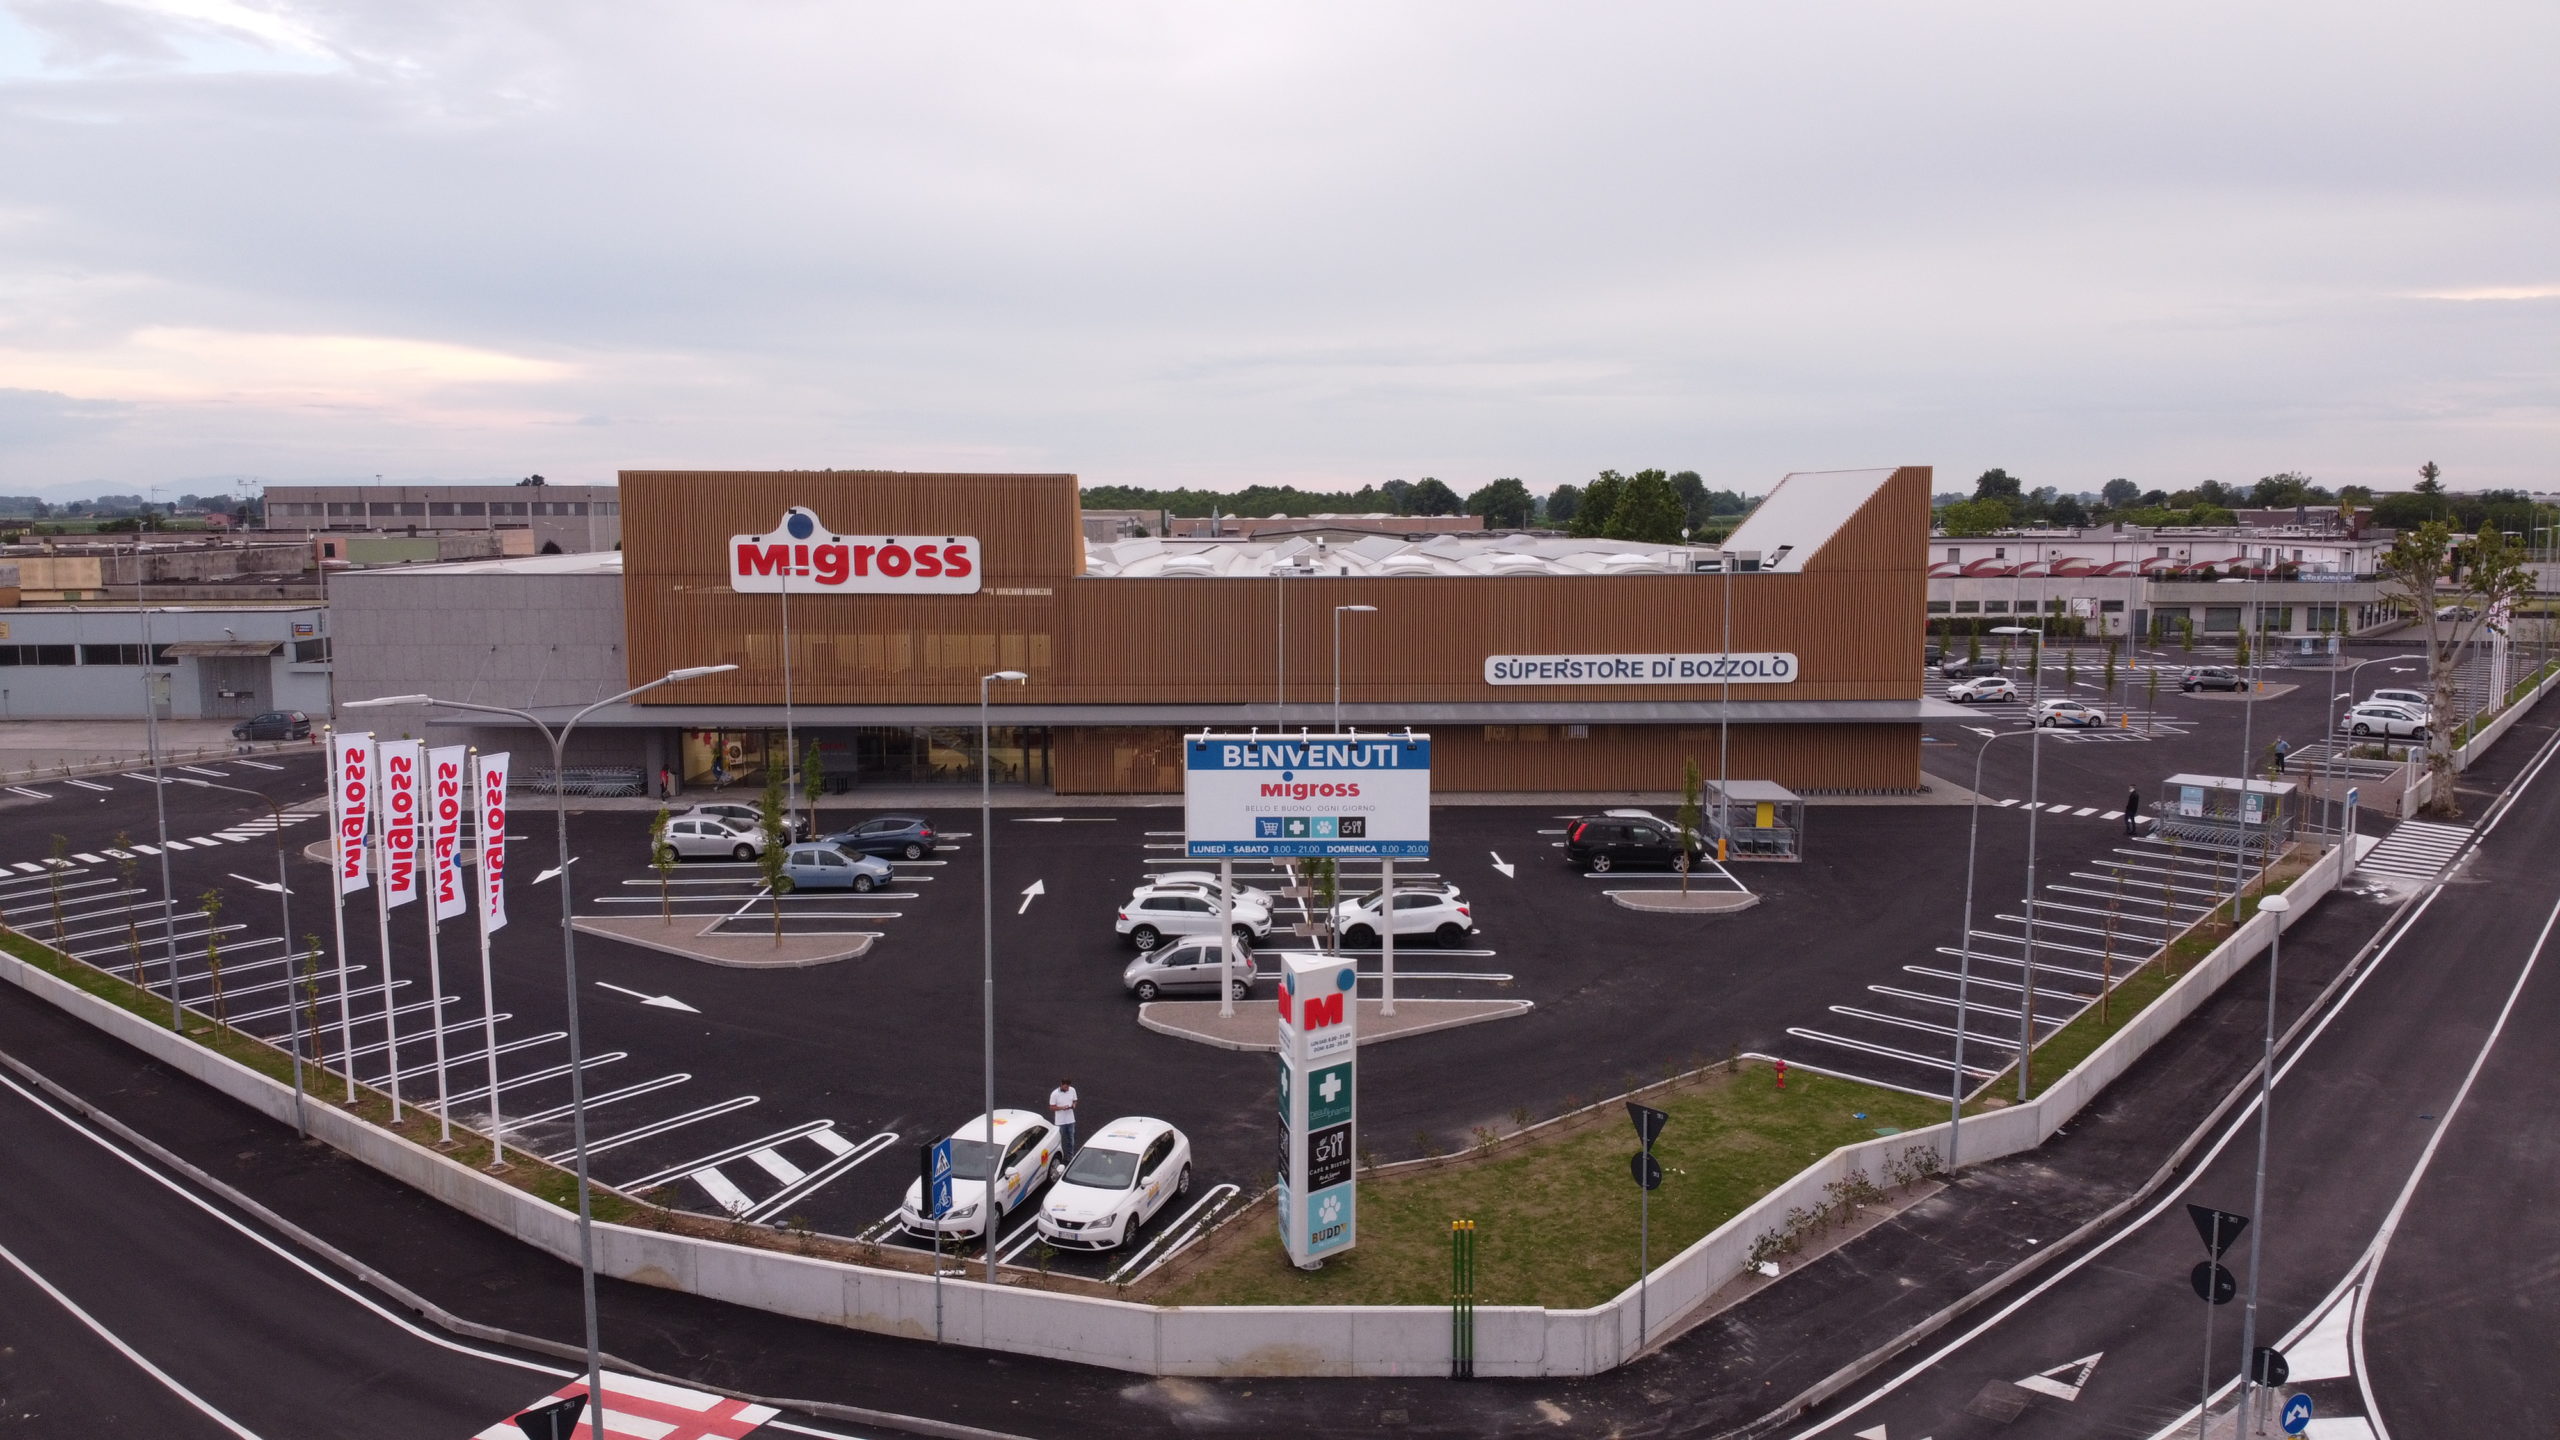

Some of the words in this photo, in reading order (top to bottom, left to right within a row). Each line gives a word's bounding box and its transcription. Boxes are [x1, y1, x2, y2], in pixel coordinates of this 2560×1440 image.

[1494, 660, 1644, 679] SUPERSTORE
[1652, 660, 1673, 678] DI
[1681, 658, 1789, 678] BOZZOLO
[1223, 745, 1398, 767] BENVENUTI
[1193, 844, 1226, 854] LUNEDÌ
[1233, 845, 1269, 854] SABATO
[1273, 845, 1291, 854] 8.00
[1298, 845, 1320, 854] 21.00
[1326, 845, 1378, 854] DOMENICA
[1381, 845, 1399, 854] 8.00
[1406, 845, 1429, 854] 20.00
[1304, 993, 1343, 1030] M
[1312, 1223, 1347, 1244] BUDDY
